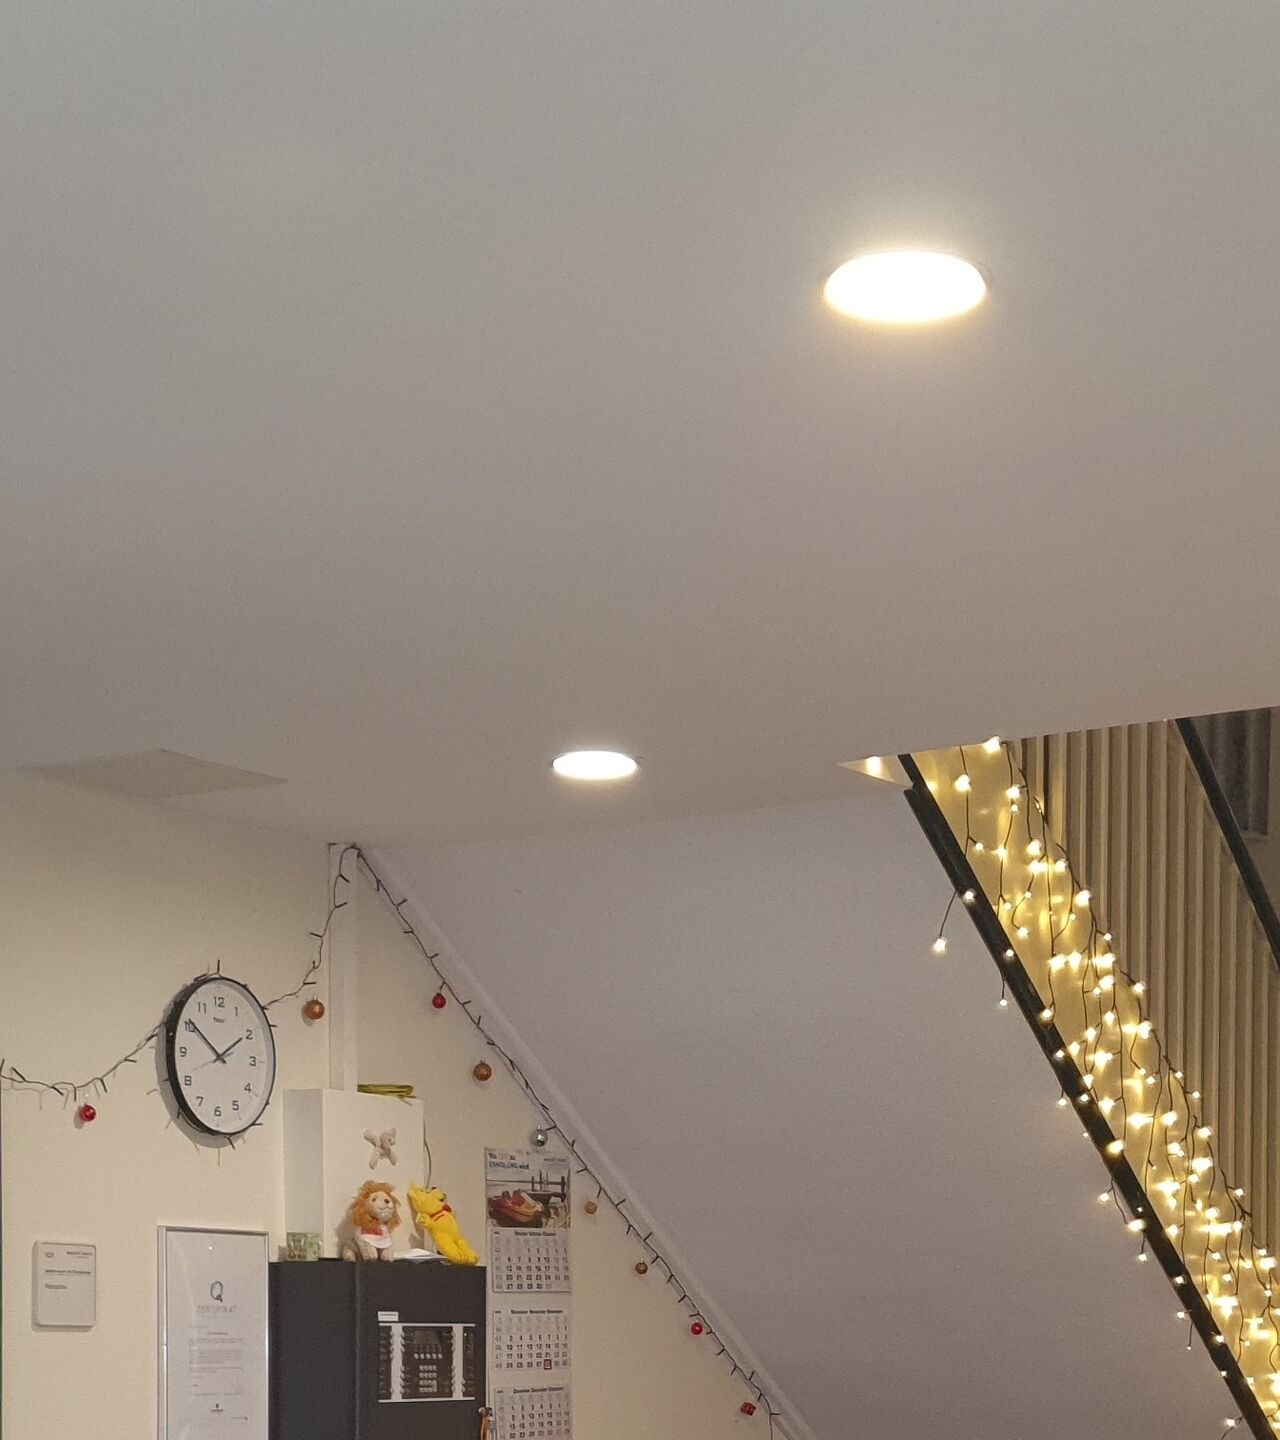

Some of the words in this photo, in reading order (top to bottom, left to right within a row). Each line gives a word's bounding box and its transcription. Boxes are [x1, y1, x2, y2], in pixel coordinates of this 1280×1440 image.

[214, 996, 225, 1008] 12
[197, 1002, 207, 1014] 11
[246, 1029, 253, 1040] 2
[179, 1047, 187, 1057] 9
[249, 1056, 256, 1067] 3
[184, 1075, 192, 1086] 8
[244, 1082, 252, 1093] 4
[196, 1096, 204, 1107] 7
[232, 1100, 240, 1111] 5
[214, 1106, 222, 1117] 6
